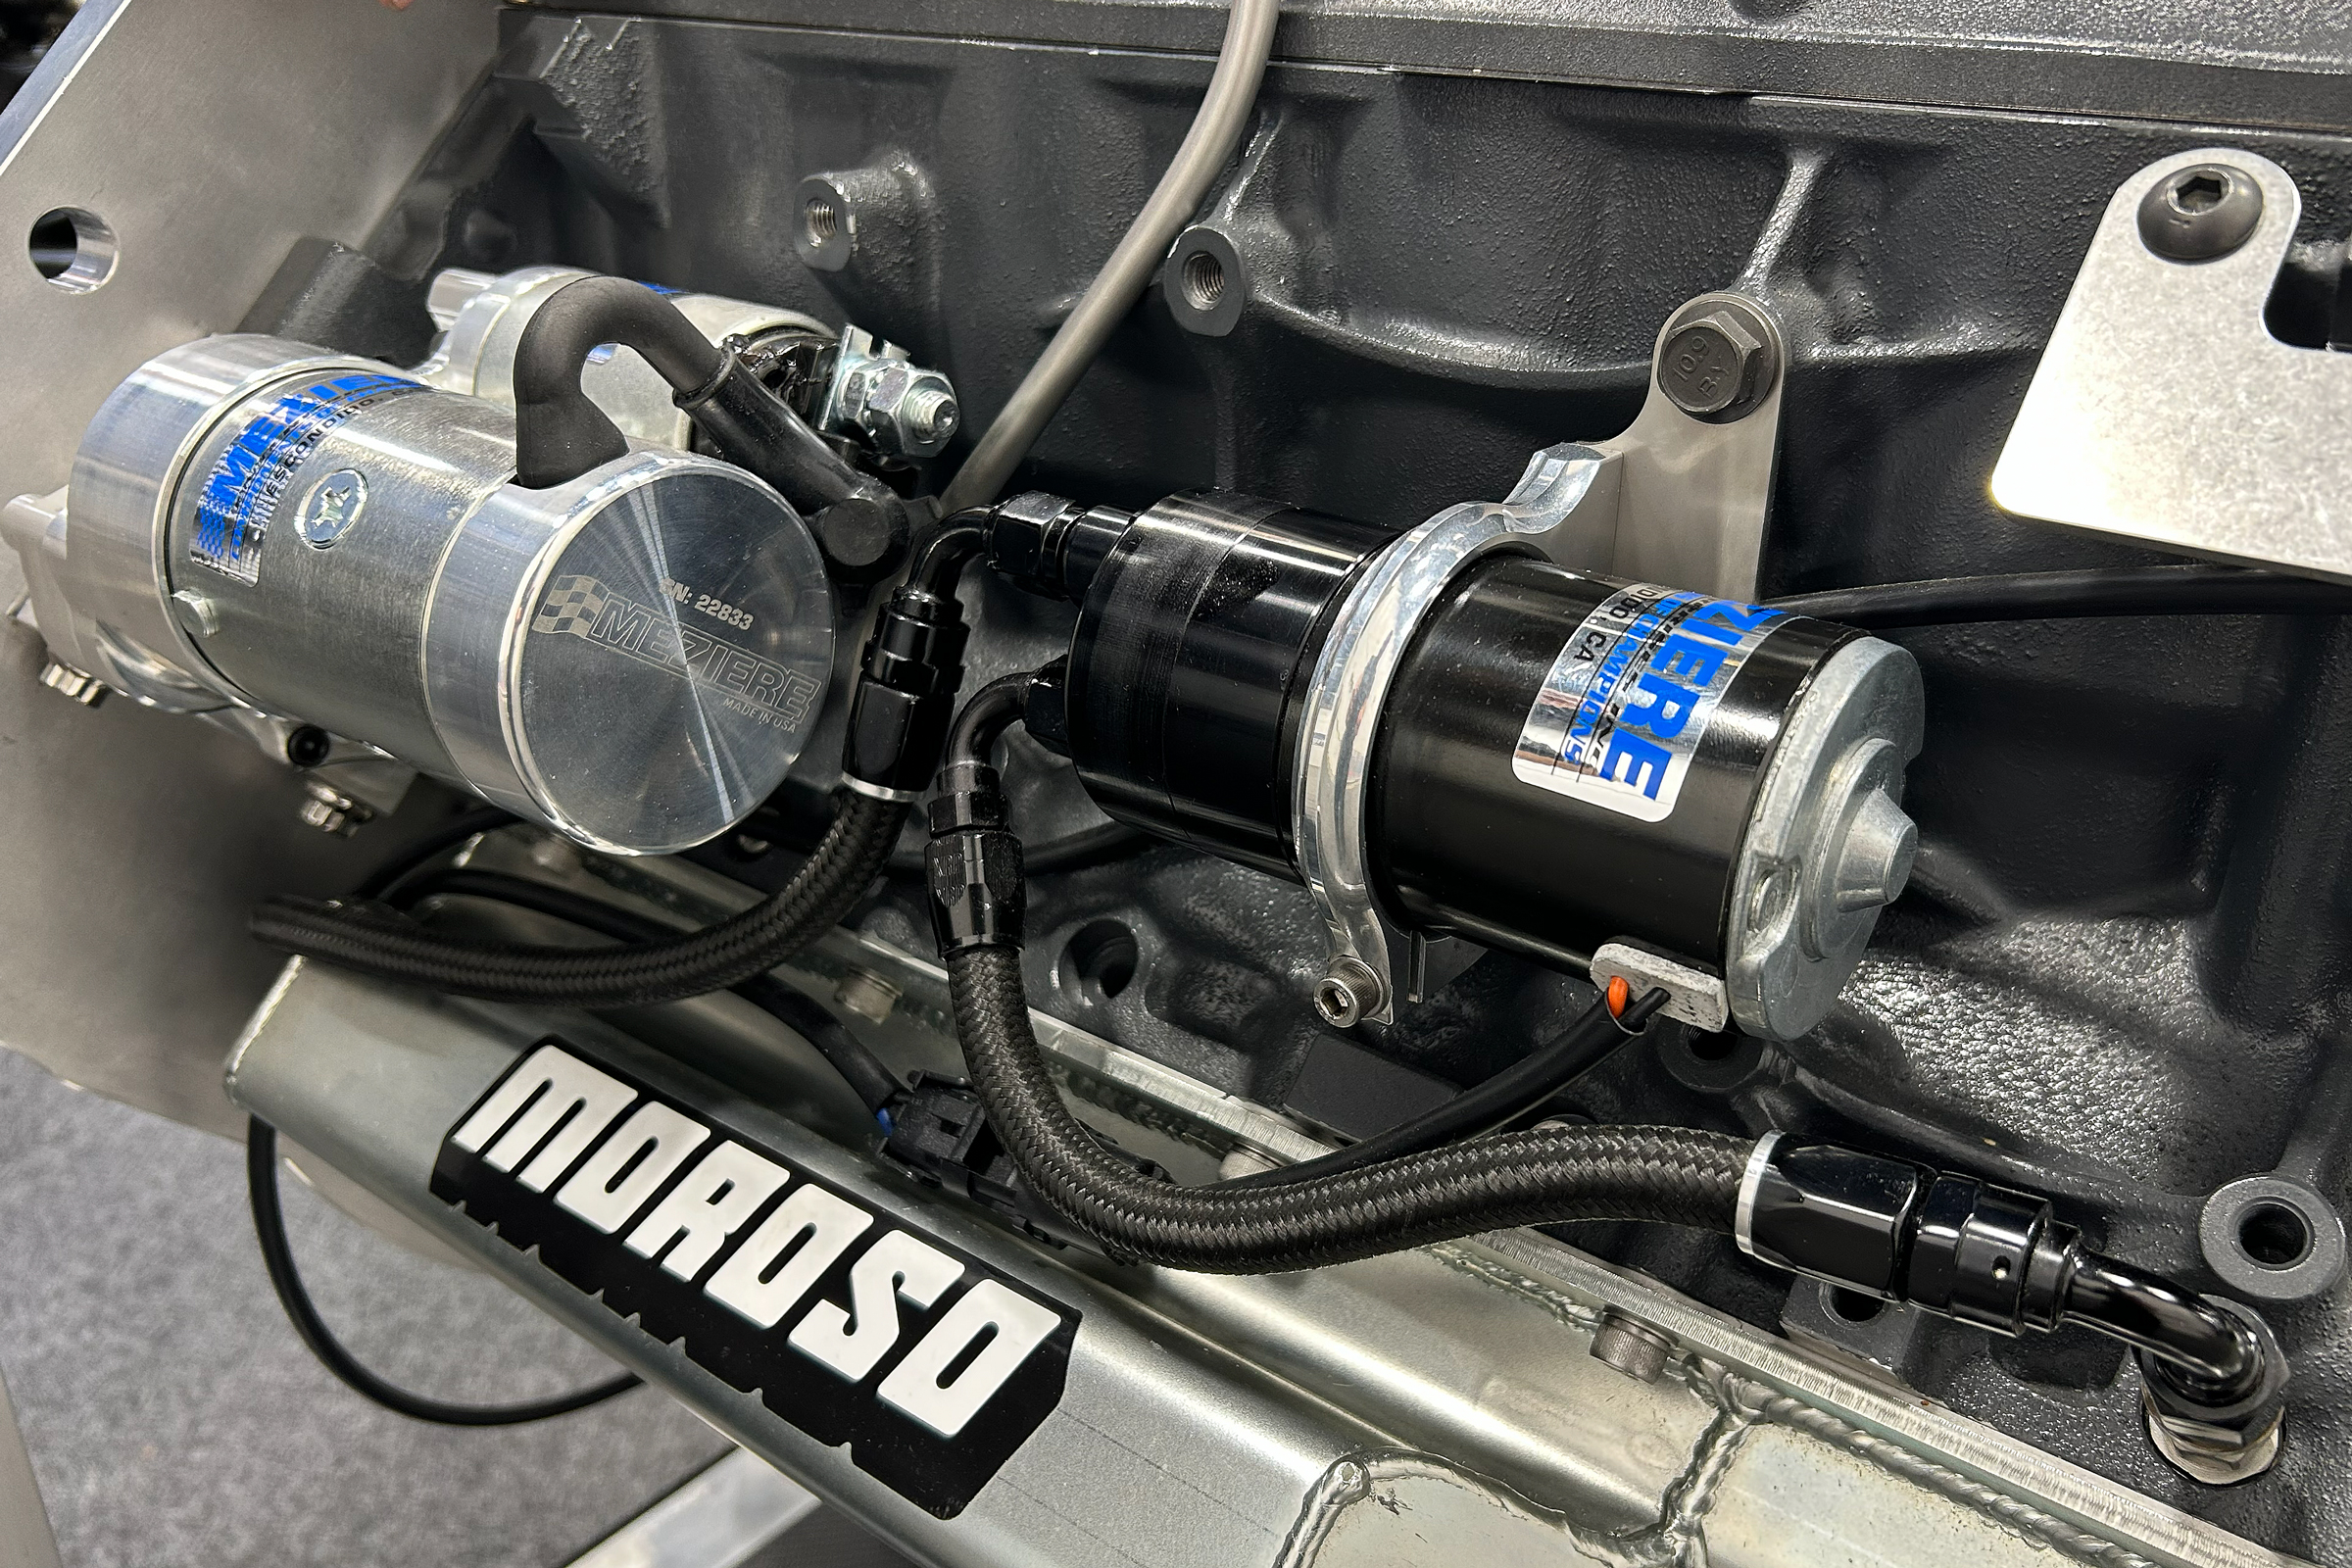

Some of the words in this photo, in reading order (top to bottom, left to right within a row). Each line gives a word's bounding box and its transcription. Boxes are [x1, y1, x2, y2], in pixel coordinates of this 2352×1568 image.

[1672, 335, 1710, 382] 10.9
[694, 593, 755, 631] 22833
[1655, 598, 1683, 617] OF
[590, 597, 821, 721] MEZIERE
[1573, 631, 1607, 662] CA
[1564, 613, 1660, 764] CHAMPIONS
[722, 697, 760, 717] MADE
[758, 710, 772, 725] IN
[772, 713, 797, 733] USA
[451, 1044, 1062, 1439] MOROSO
